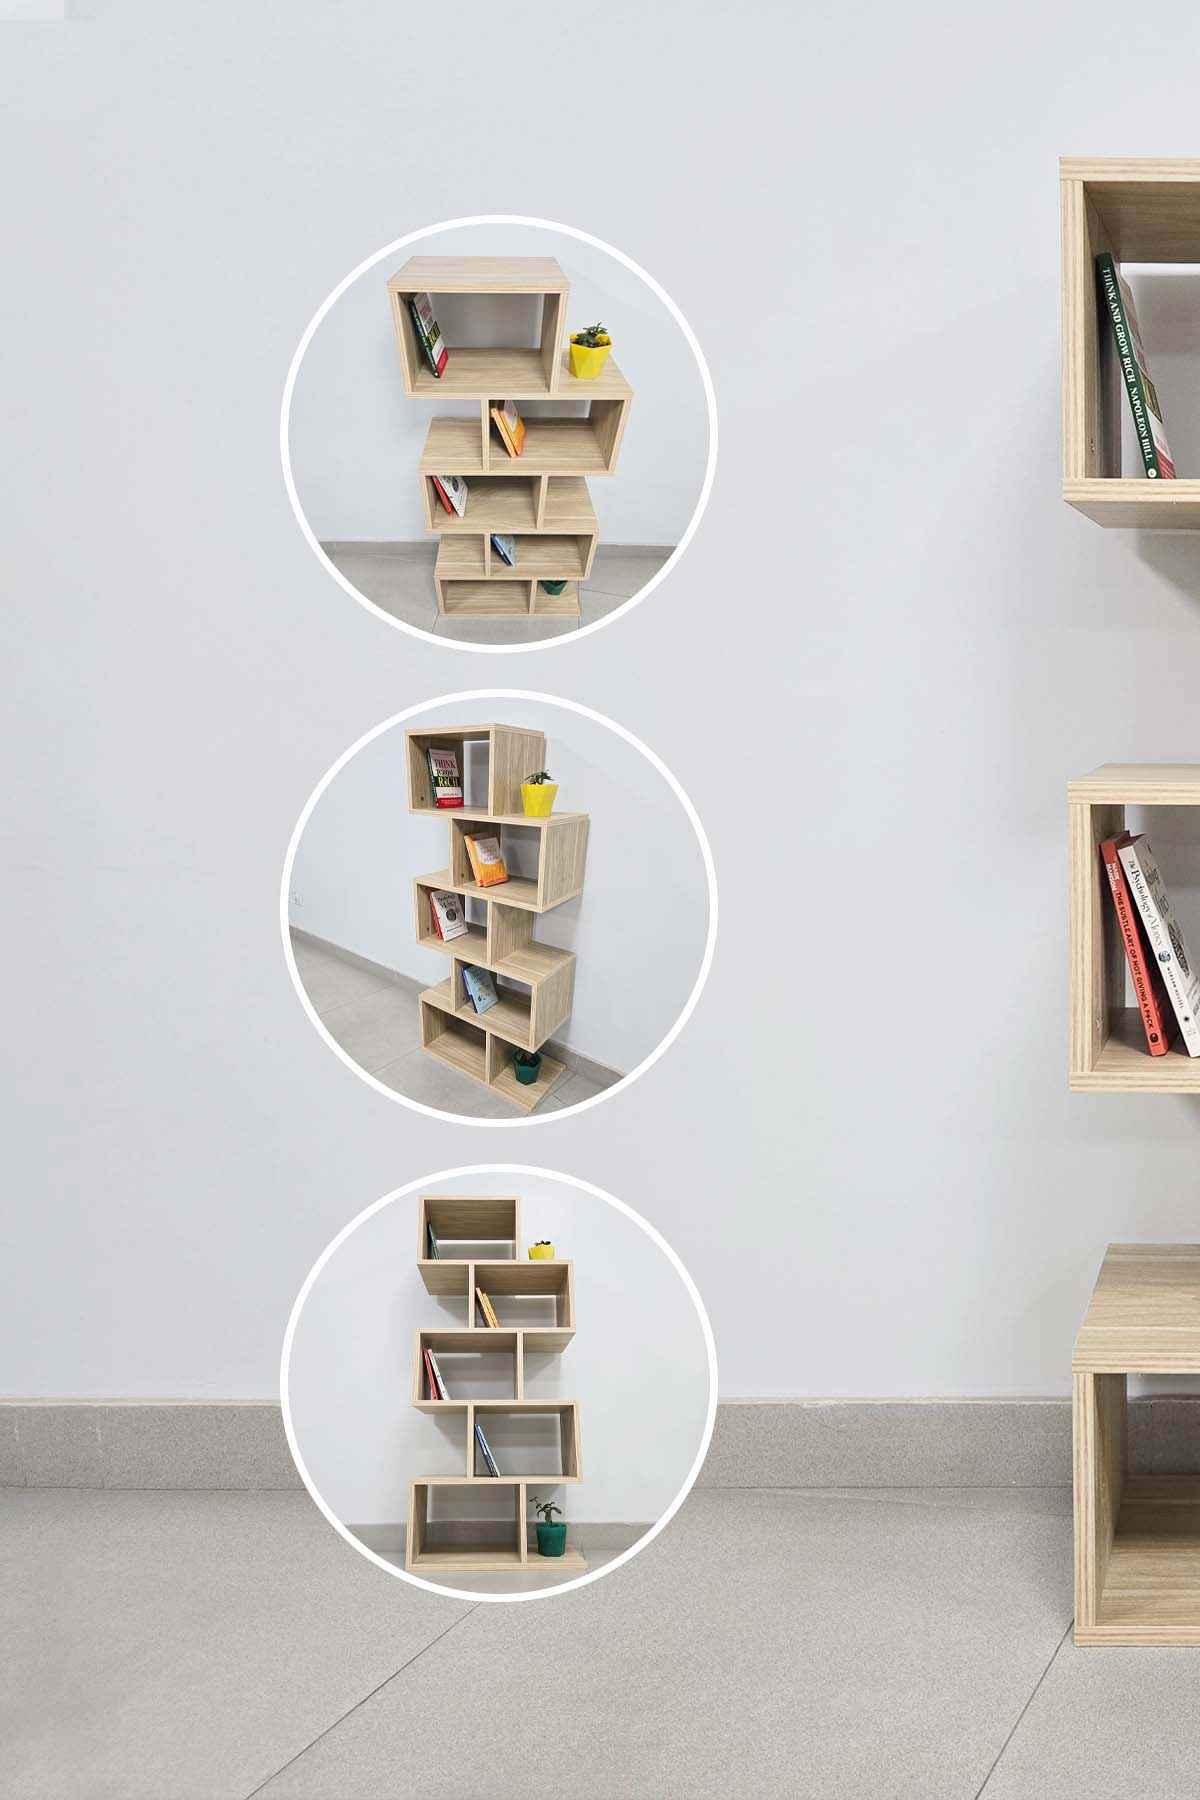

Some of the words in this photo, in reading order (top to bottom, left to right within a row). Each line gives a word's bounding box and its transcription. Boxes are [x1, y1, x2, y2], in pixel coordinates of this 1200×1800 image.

[1102, 268, 1117, 300] THINK
[1108, 300, 1121, 322] AND
[1114, 322, 1130, 356] GROW
[1121, 356, 1135, 383] RICH
[1130, 387, 1148, 437] NAPOLEON
[1140, 438, 1154, 462] HILL
[1114, 891, 1125, 906] THE
[1130, 869, 1152, 914] Psychology
[1148, 919, 1163, 946] Money
[1117, 905, 1132, 934] SUBTLE
[1124, 932, 1135, 948] ART
[1128, 947, 1137, 959] OF
[1130, 959, 1141, 976] NOT
[1134, 975, 1148, 1002] GIVING
[1141, 1001, 1149, 1009] A
